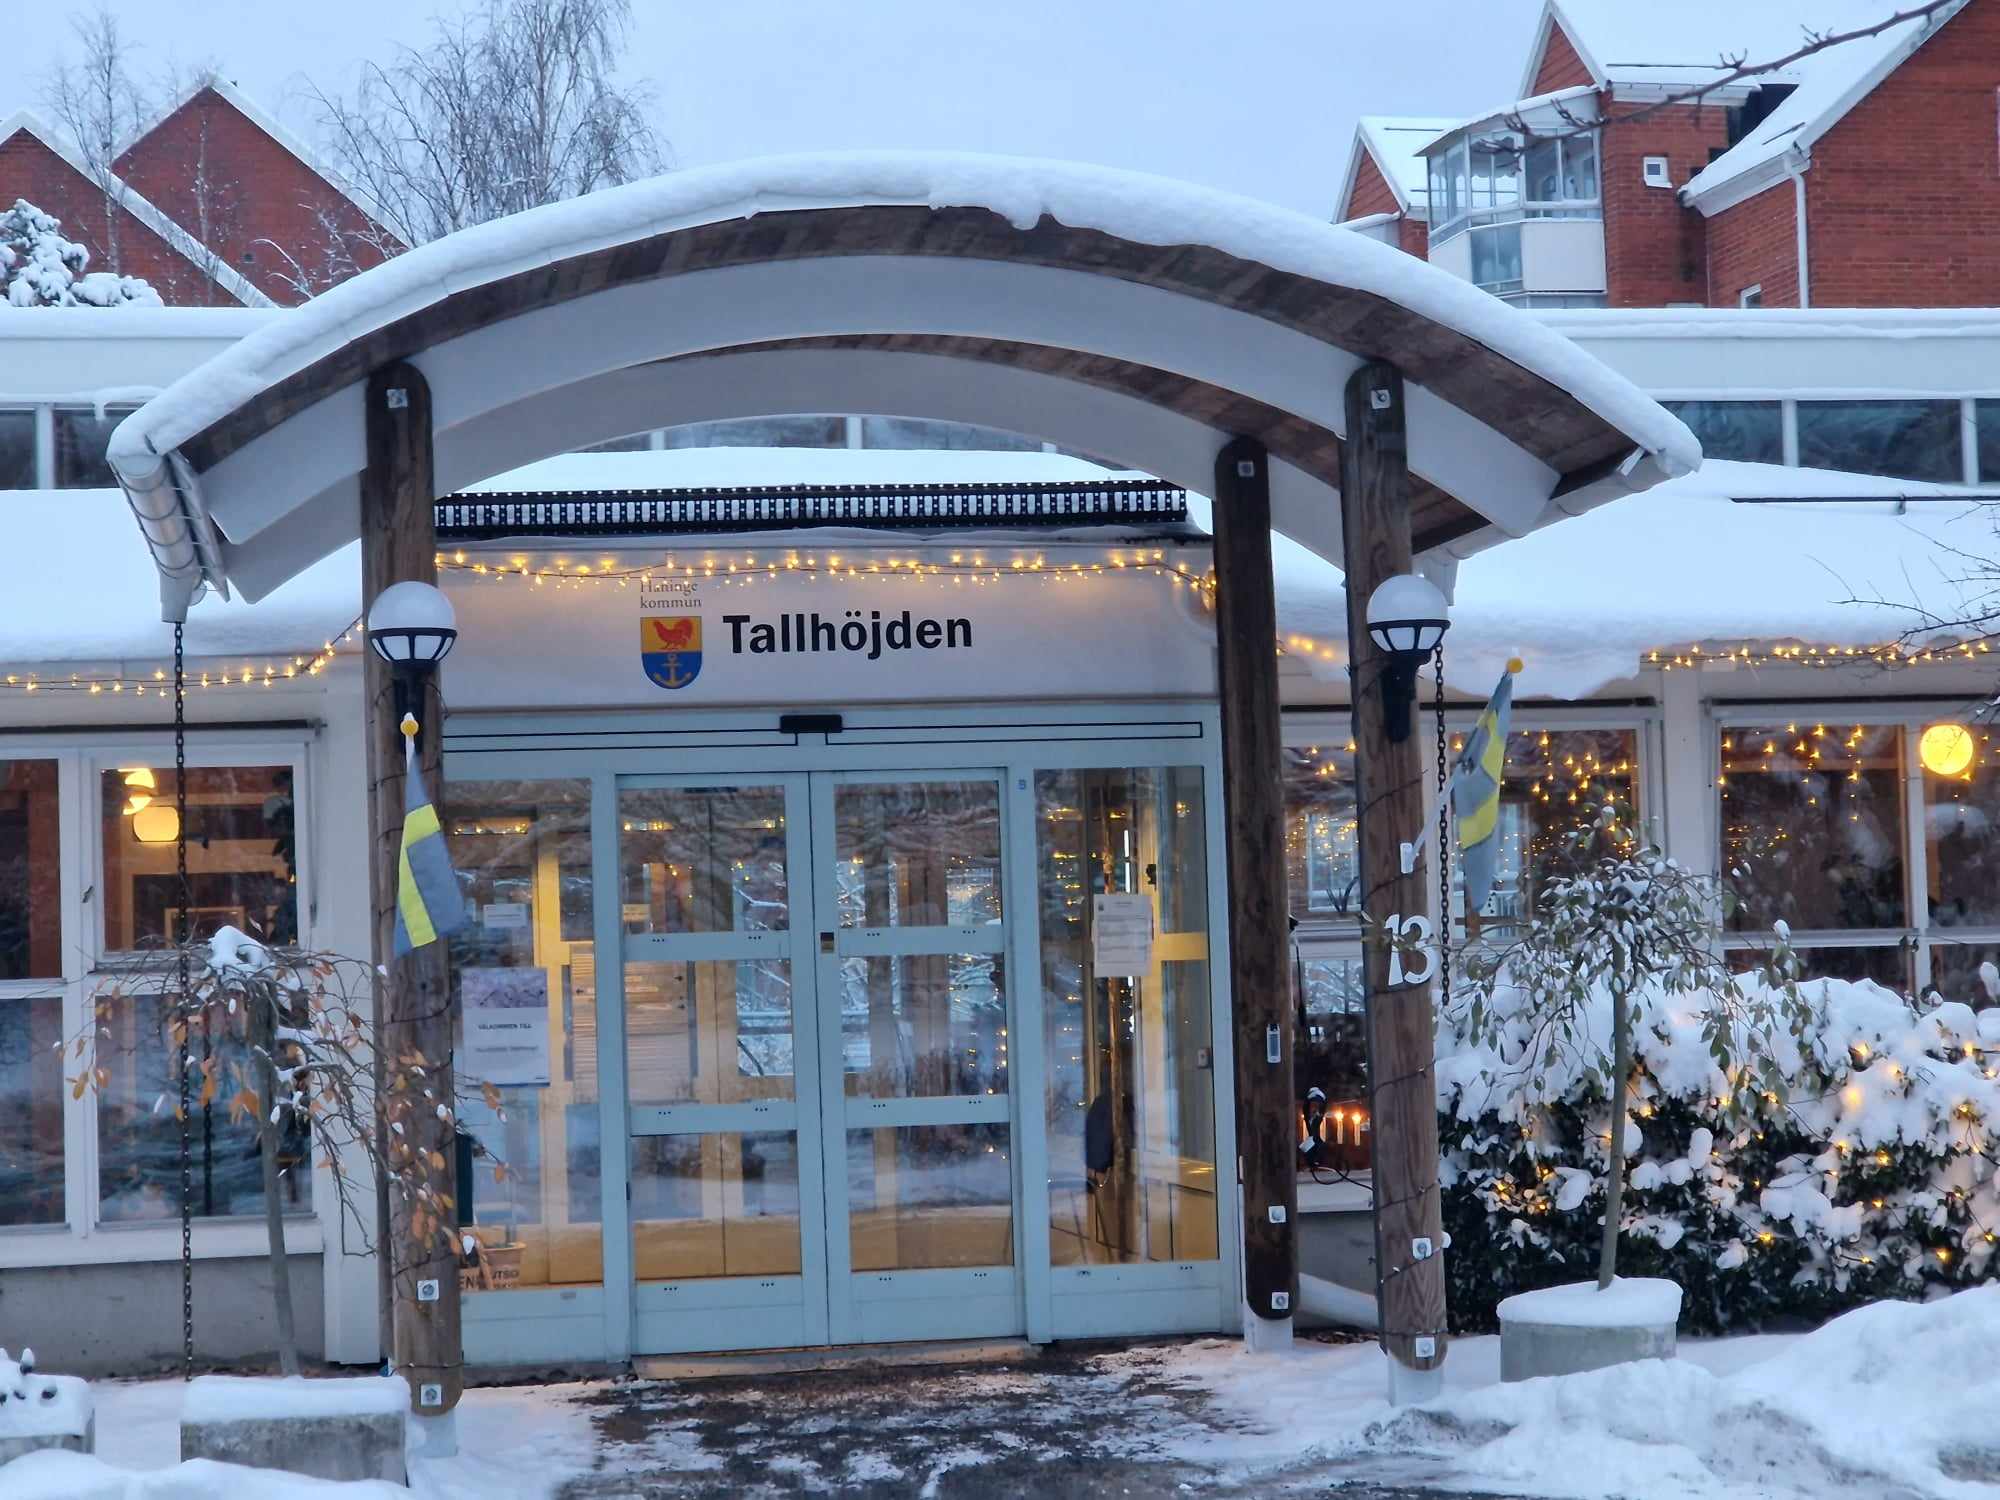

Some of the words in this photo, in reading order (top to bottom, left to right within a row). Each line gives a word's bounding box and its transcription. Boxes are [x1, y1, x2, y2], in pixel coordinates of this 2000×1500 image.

[640, 595, 702, 609] kommun
[722, 610, 973, 660] Tallhöjden
[1384, 913, 1435, 986] 13
